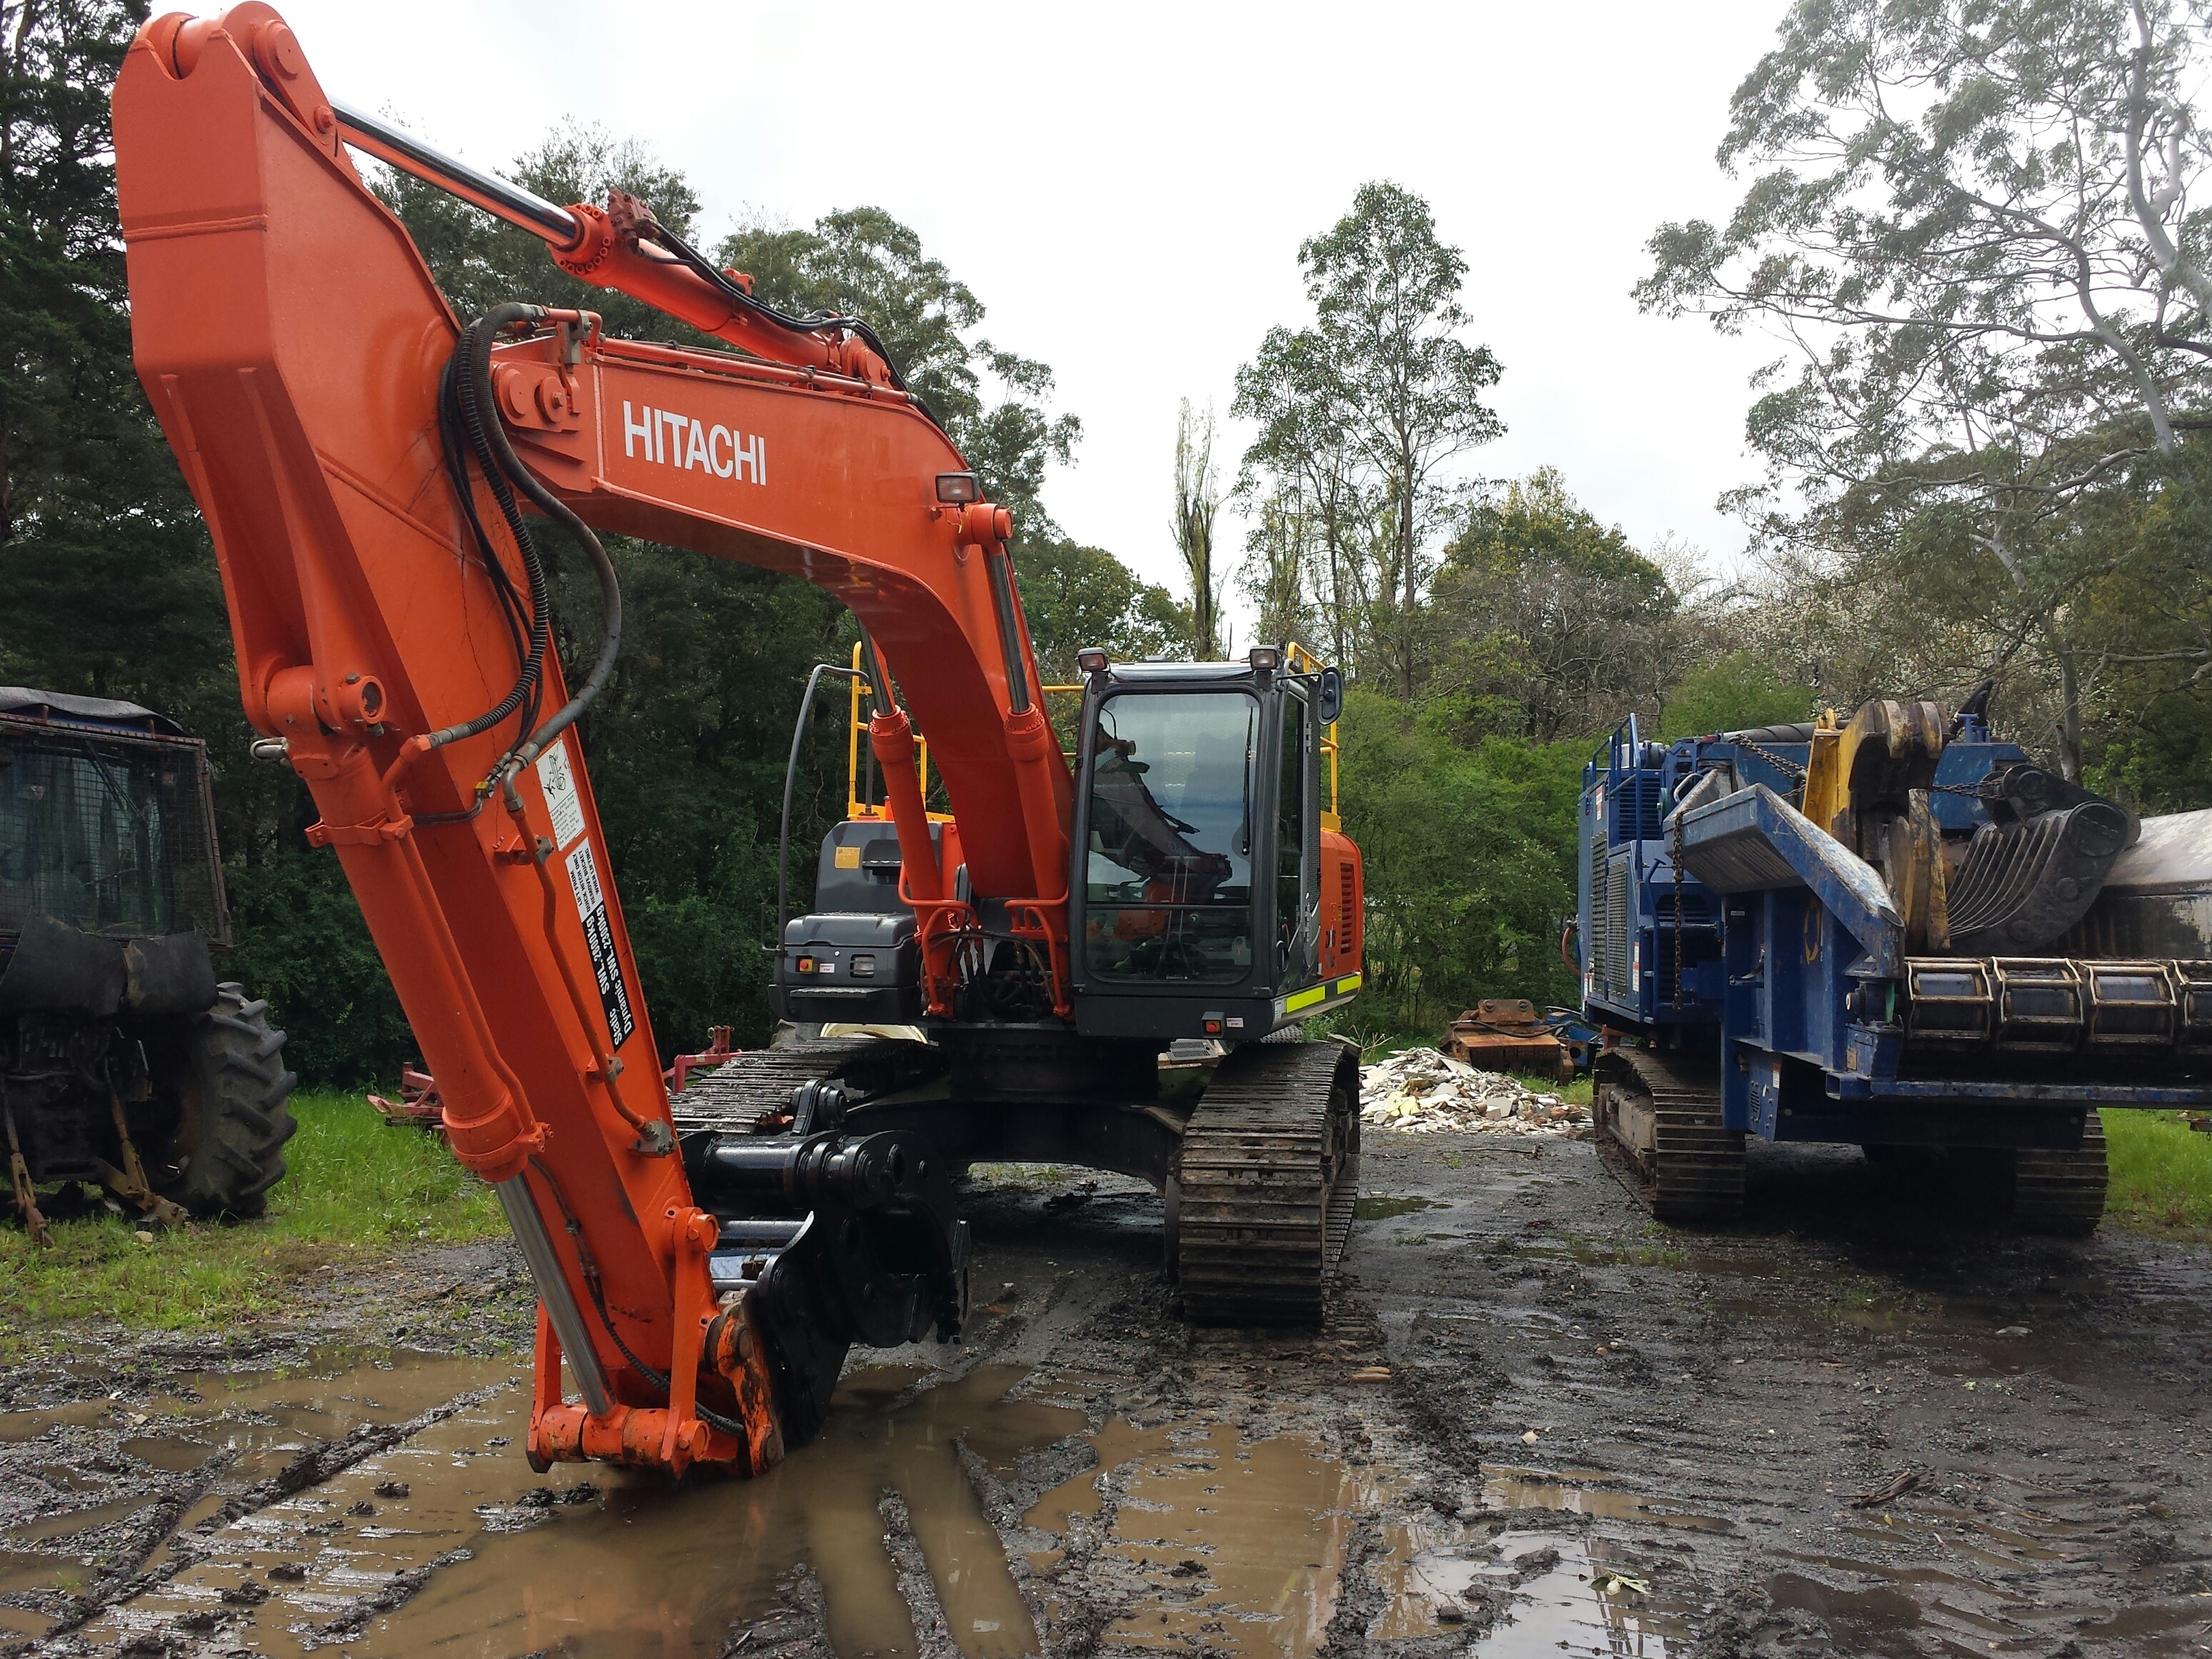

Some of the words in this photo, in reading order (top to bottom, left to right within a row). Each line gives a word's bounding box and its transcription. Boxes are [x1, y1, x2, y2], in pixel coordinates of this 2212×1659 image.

[623, 400, 767, 486] HITACHI
[578, 850, 588, 876] BUCKET
[584, 847, 594, 874] LIFTING
[577, 870, 585, 891] HITCH
[585, 876, 595, 905] REMOVE
[614, 979, 632, 1034] Dynamic
[609, 1008, 622, 1045] Static
